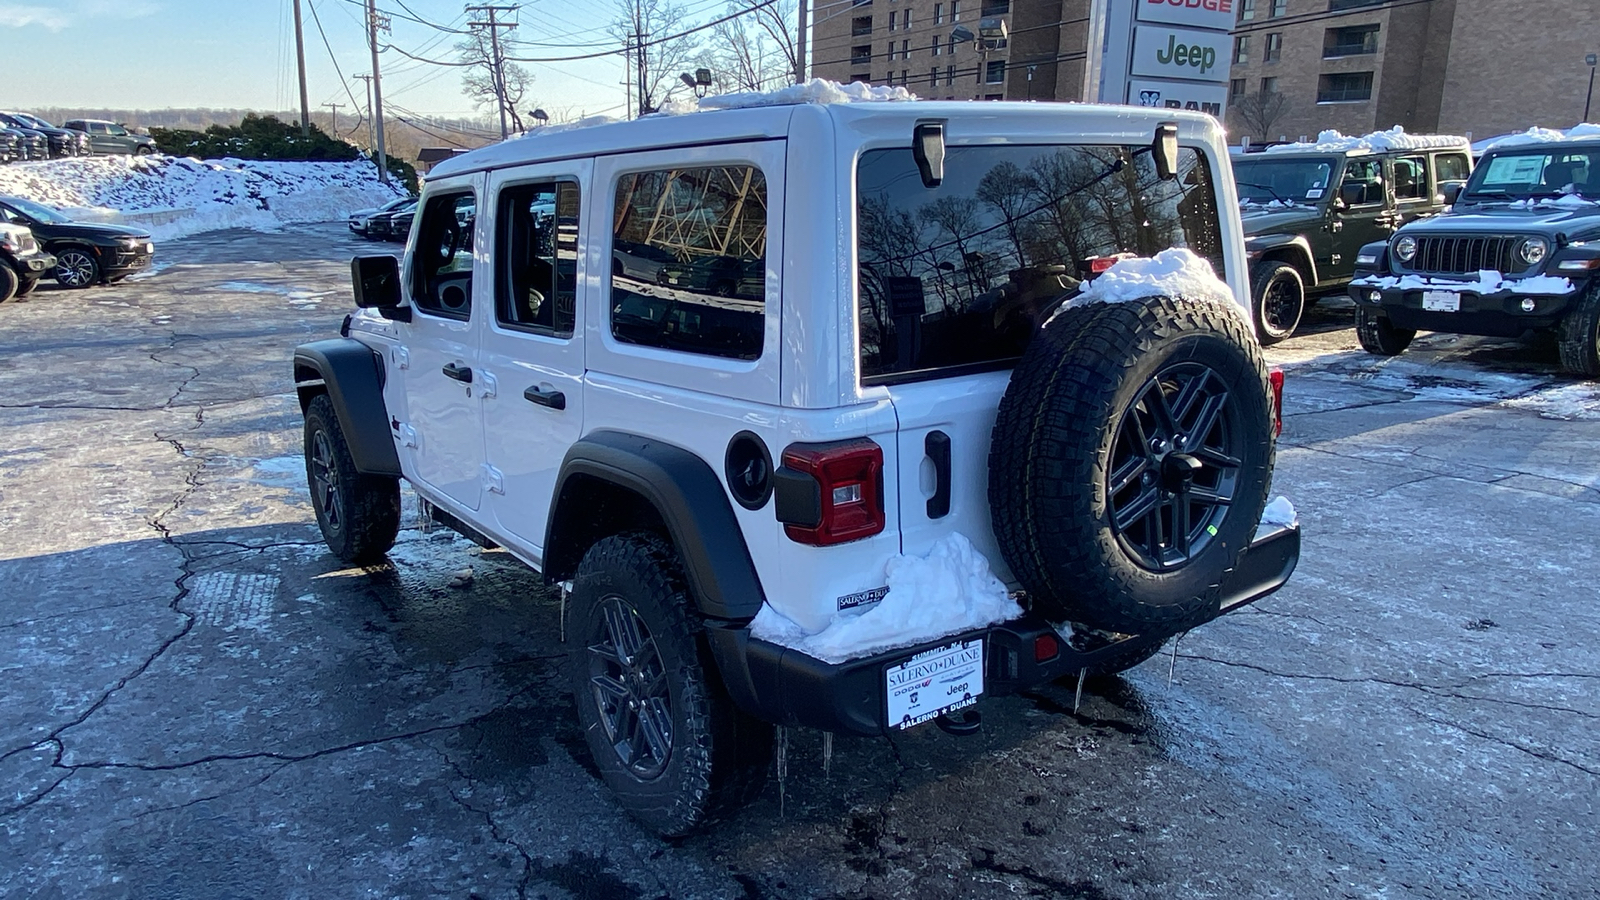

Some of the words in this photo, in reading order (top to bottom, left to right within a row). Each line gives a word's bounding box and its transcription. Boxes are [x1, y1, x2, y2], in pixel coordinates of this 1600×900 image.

[1148, 0, 1232, 13] DGE
[1156, 34, 1216, 74] Jeep
[1164, 99, 1221, 116] RAM
[840, 594, 869, 606] SALERNO
[874, 587, 891, 598] DUA
[889, 662, 938, 687] SALERNO
[943, 648, 980, 669] DUANE
[946, 682, 969, 696] Jeep
[900, 710, 939, 730] SALERNO
[950, 696, 978, 712] DUANE
